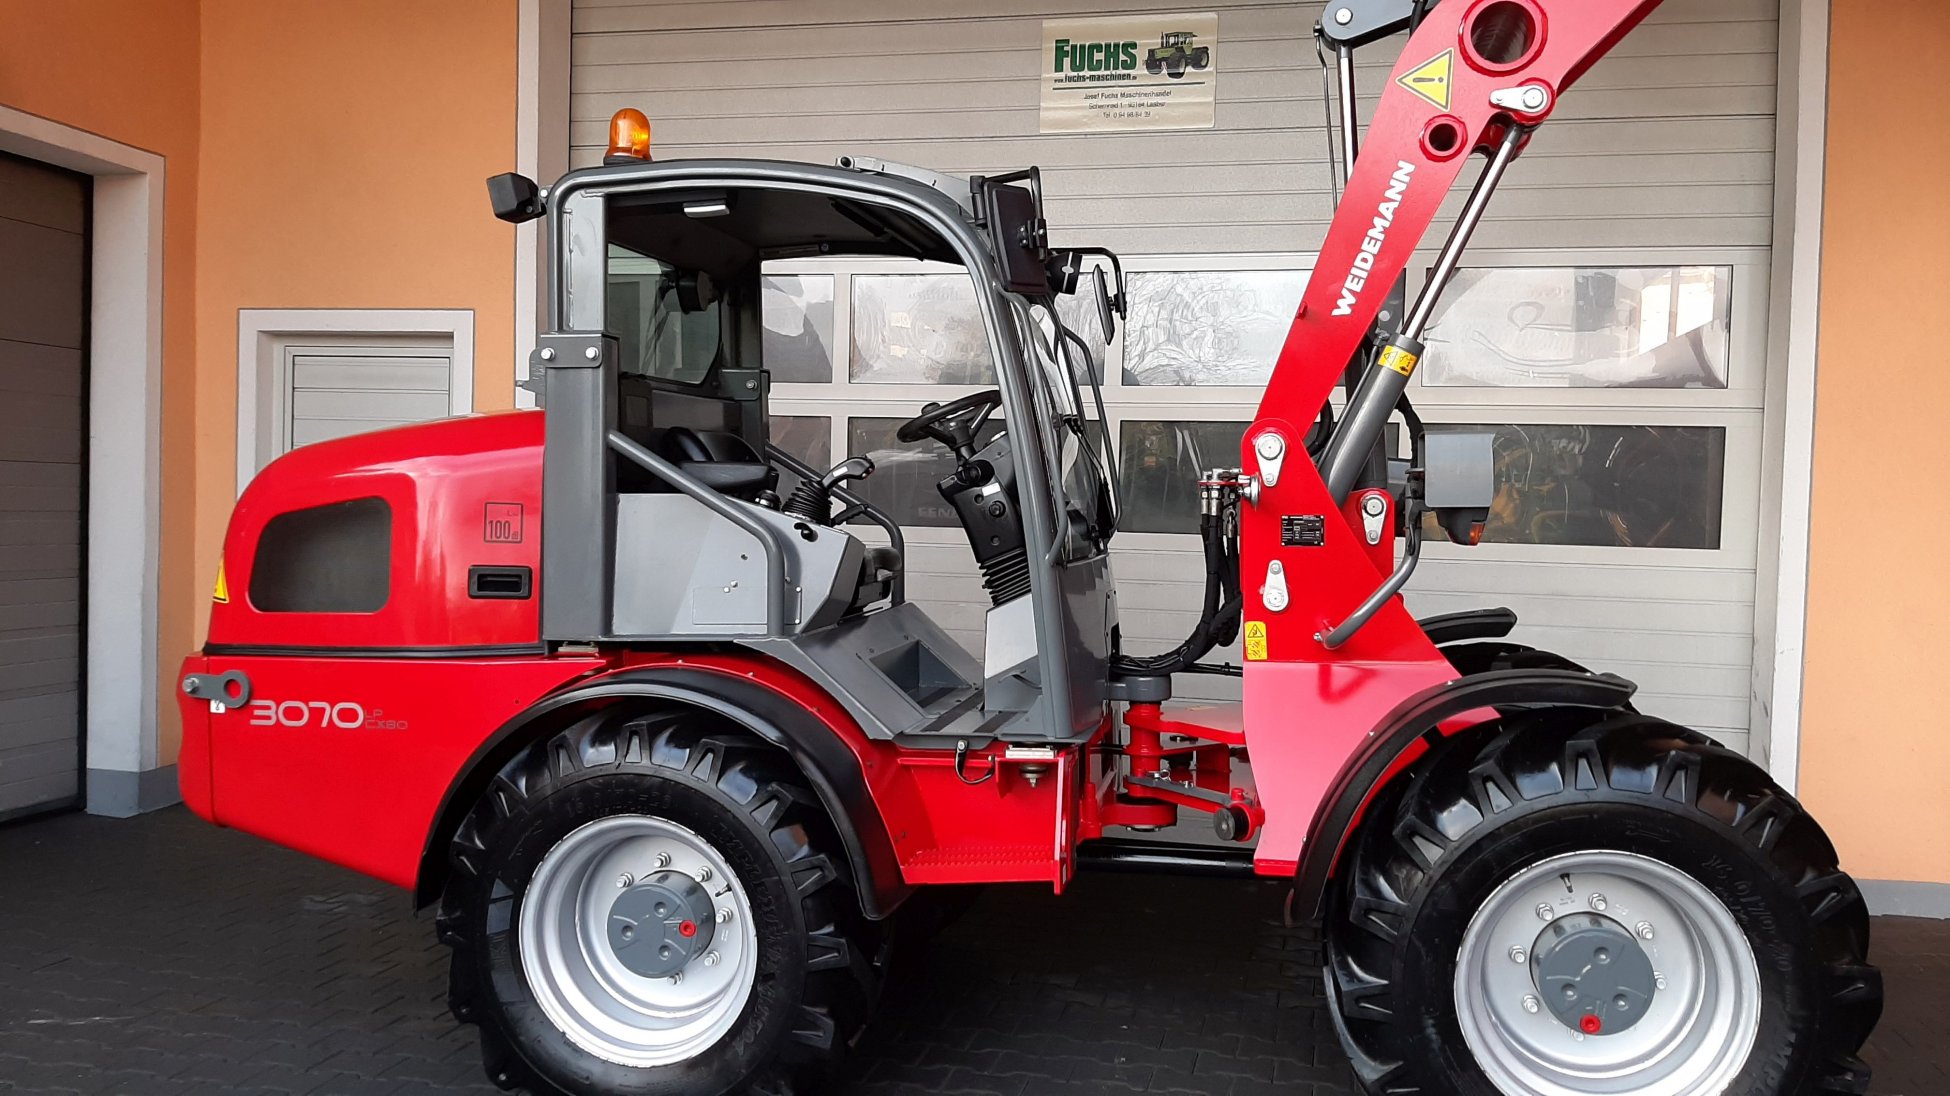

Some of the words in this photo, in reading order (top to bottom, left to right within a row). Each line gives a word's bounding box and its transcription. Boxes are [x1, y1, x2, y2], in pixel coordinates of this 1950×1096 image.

[1120, 90, 1172, 98] Maschinenhandel
[1331, 159, 1417, 317] WEIDEMANN
[488, 520, 511, 540] 100
[250, 699, 364, 729] 3070
[365, 719, 409, 730] CX80
